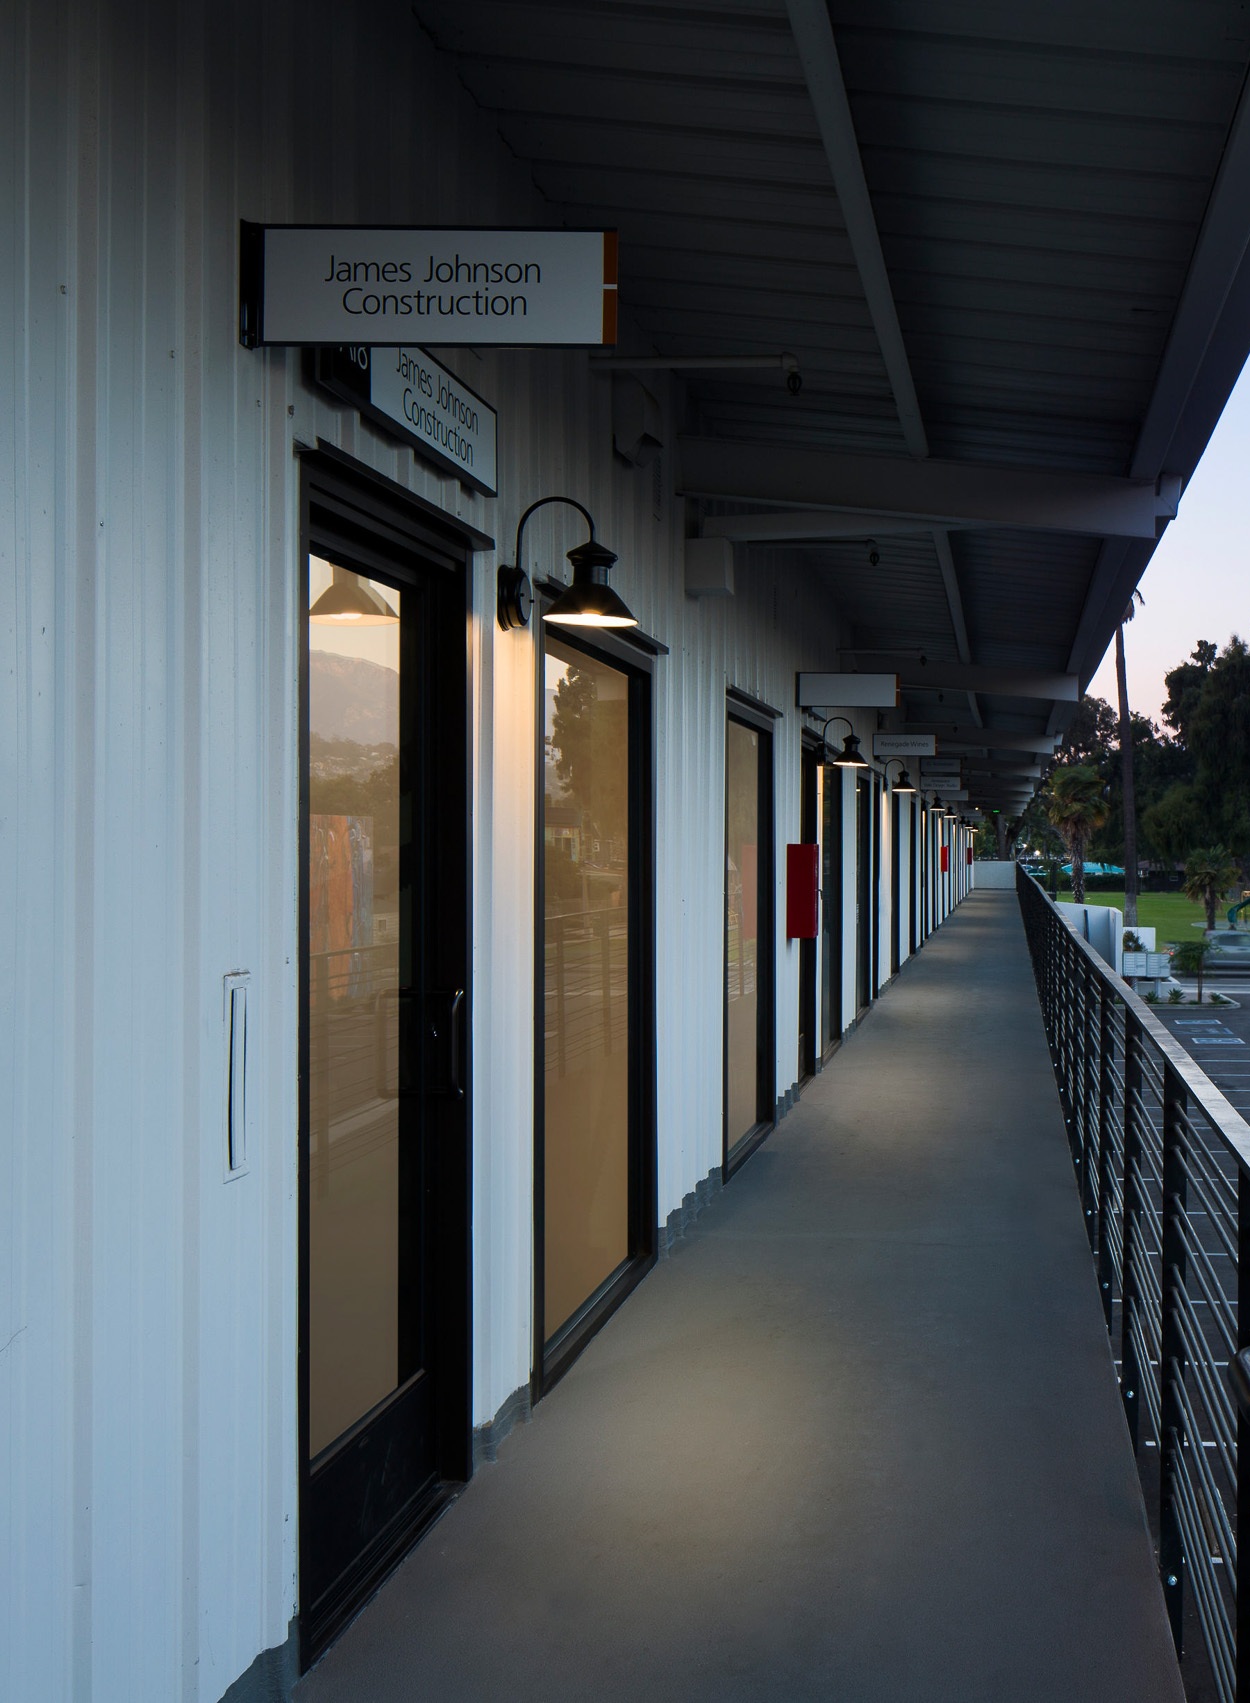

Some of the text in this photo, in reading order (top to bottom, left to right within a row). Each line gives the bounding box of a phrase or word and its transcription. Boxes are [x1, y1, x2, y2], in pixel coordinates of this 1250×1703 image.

[324, 253, 541, 284] James Johnson
[342, 286, 527, 316] Construction
[396, 347, 434, 398] James
[436, 374, 479, 436] Johnson
[403, 387, 474, 467] Construction
[880, 740, 929, 749] Renegade Wines
